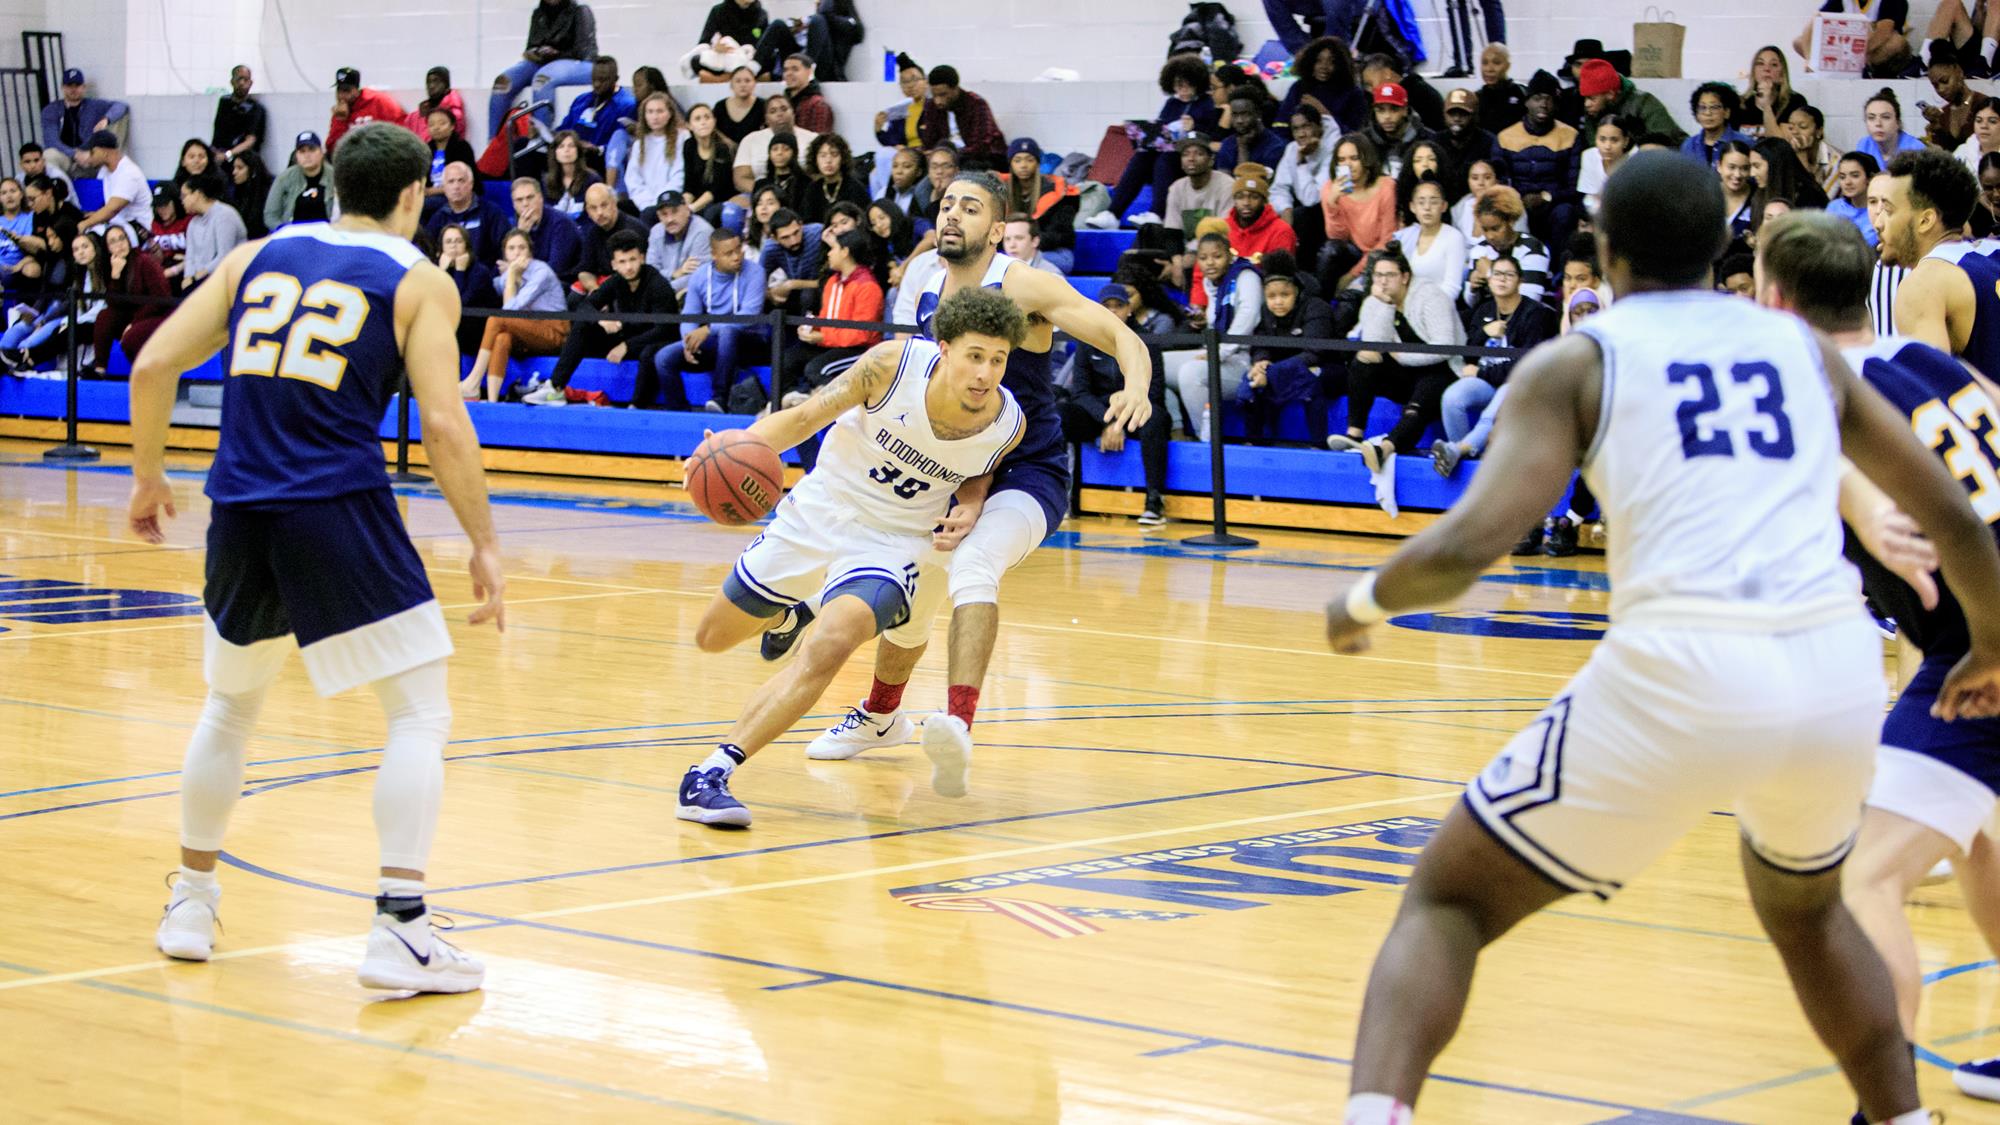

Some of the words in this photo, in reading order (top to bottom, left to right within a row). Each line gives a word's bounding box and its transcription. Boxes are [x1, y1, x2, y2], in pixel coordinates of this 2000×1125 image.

[230, 272, 371, 392] 22
[1667, 362, 1795, 459] 23
[875, 428, 965, 483] BLOODHOUNDS
[1238, 817, 1426, 848] ATHLETIC
[938, 845, 1236, 892] CONFERENCE
